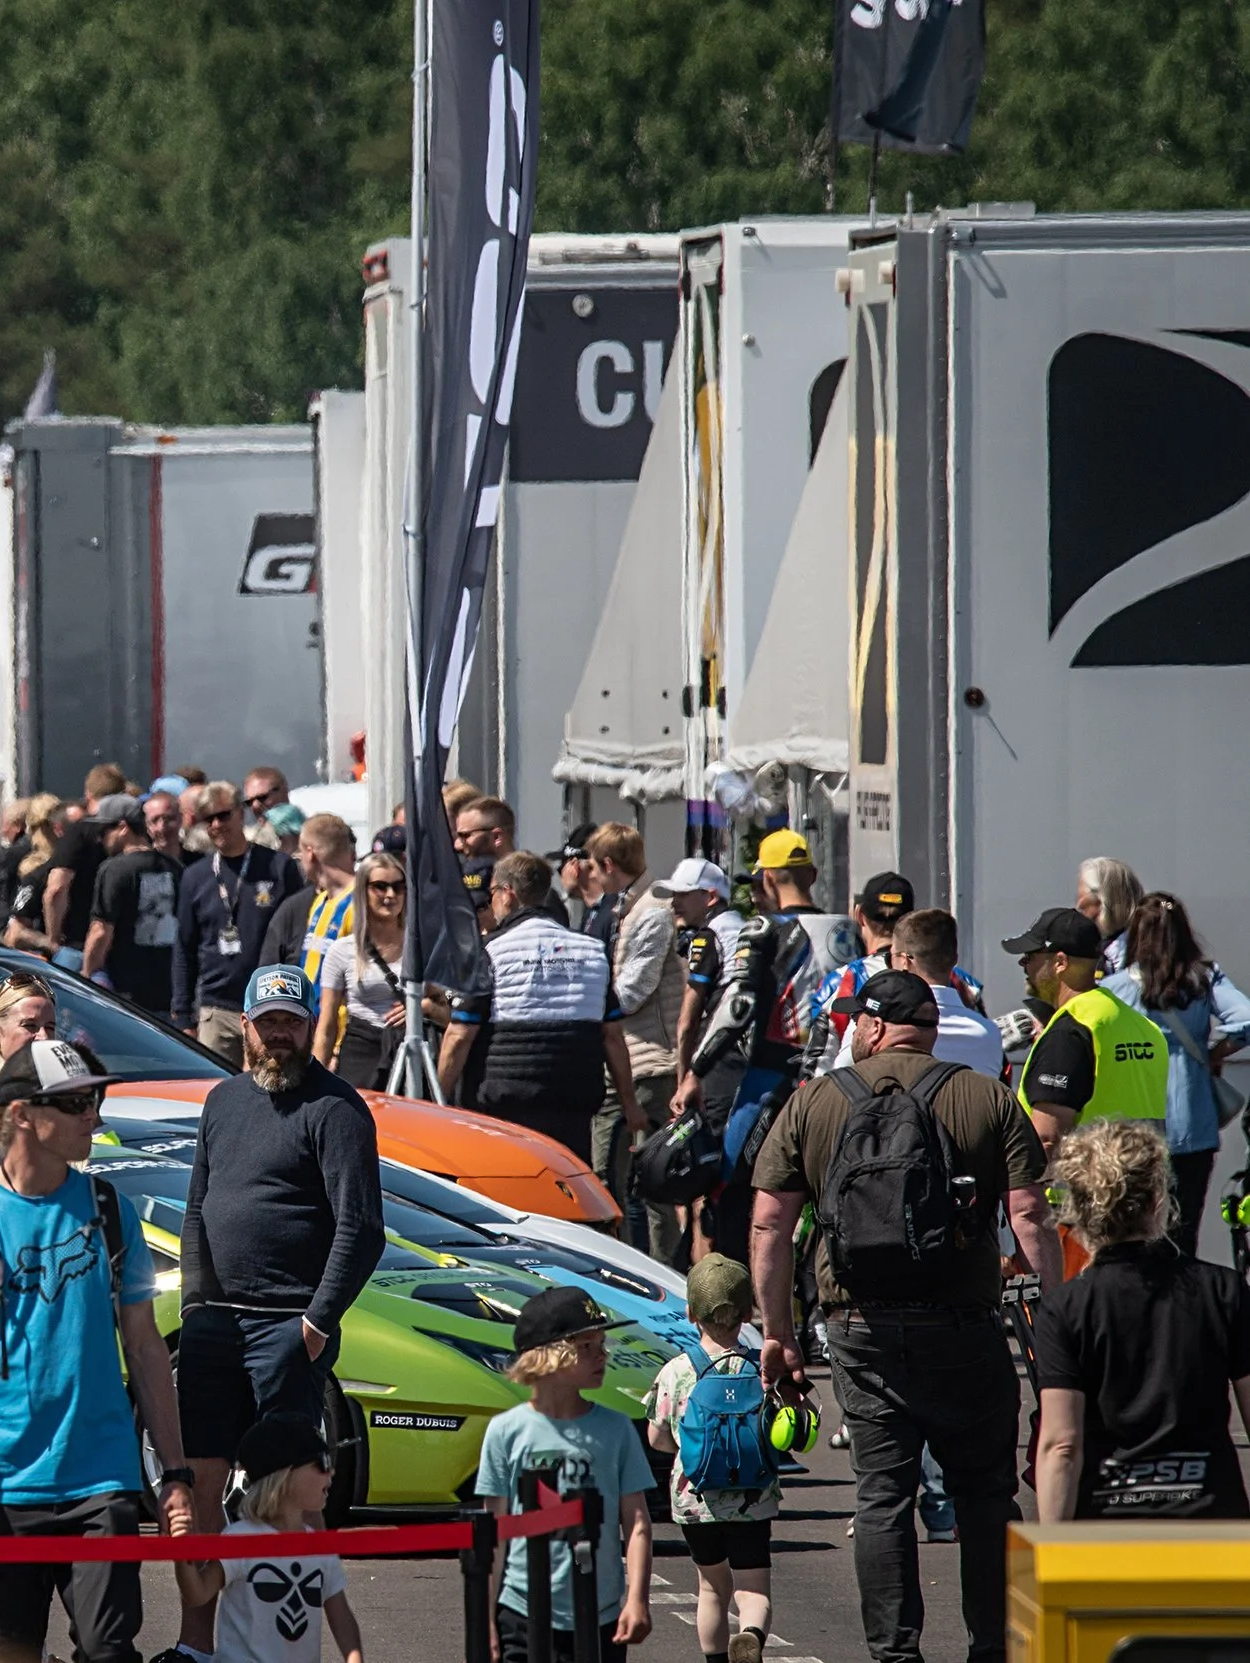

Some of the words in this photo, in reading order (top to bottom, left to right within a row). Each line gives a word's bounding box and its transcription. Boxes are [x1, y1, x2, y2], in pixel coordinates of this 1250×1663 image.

[1114, 1042, 1154, 1062] STCC
[374, 1415, 414, 1427] ROGER
[416, 1417, 458, 1429] DUBUIS
